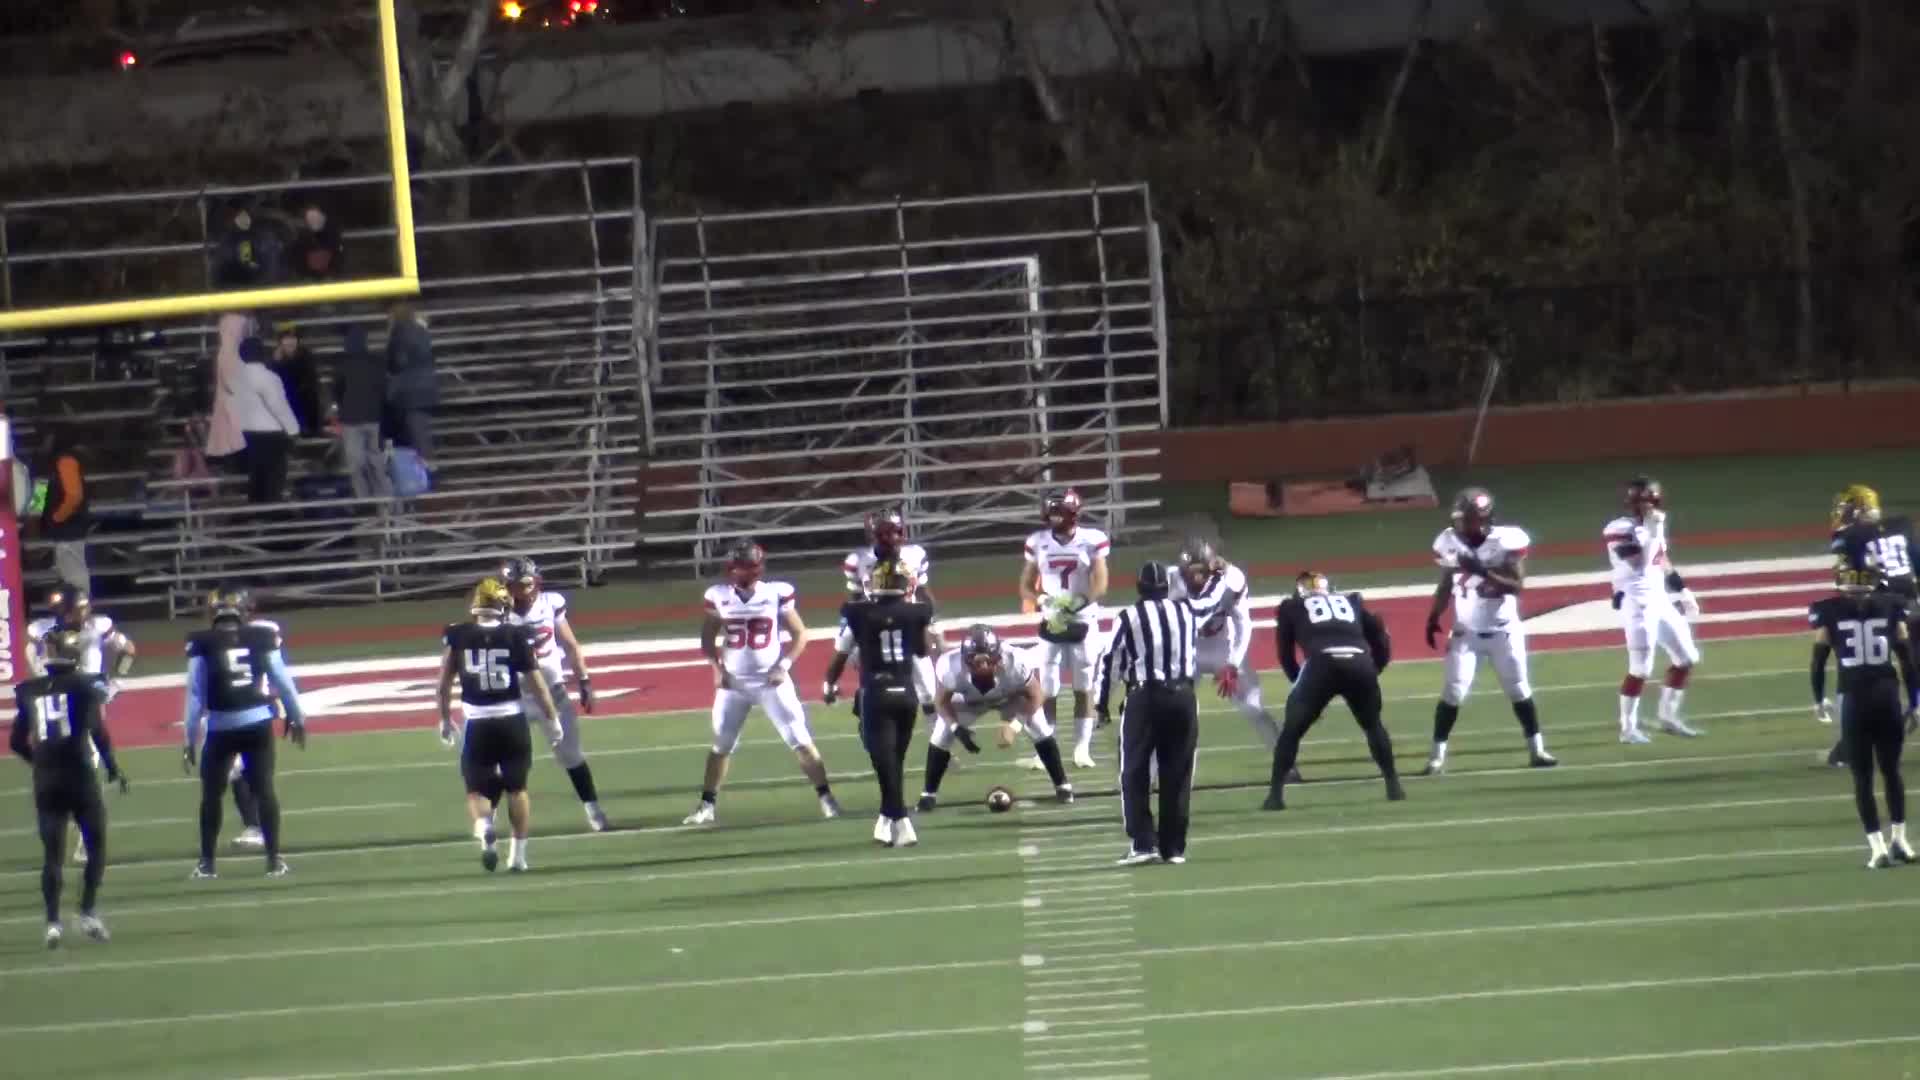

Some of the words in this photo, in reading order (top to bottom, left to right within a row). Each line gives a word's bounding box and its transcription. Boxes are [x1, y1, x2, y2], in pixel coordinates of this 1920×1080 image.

[1049, 559, 1078, 590] 7
[1304, 594, 1355, 624] 88
[725, 616, 774, 650] 58
[880, 629, 904, 662] 11
[1837, 617, 1889, 667] 36
[226, 647, 254, 687] 5
[464, 648, 511, 691] 46
[35, 693, 72, 740] 14
